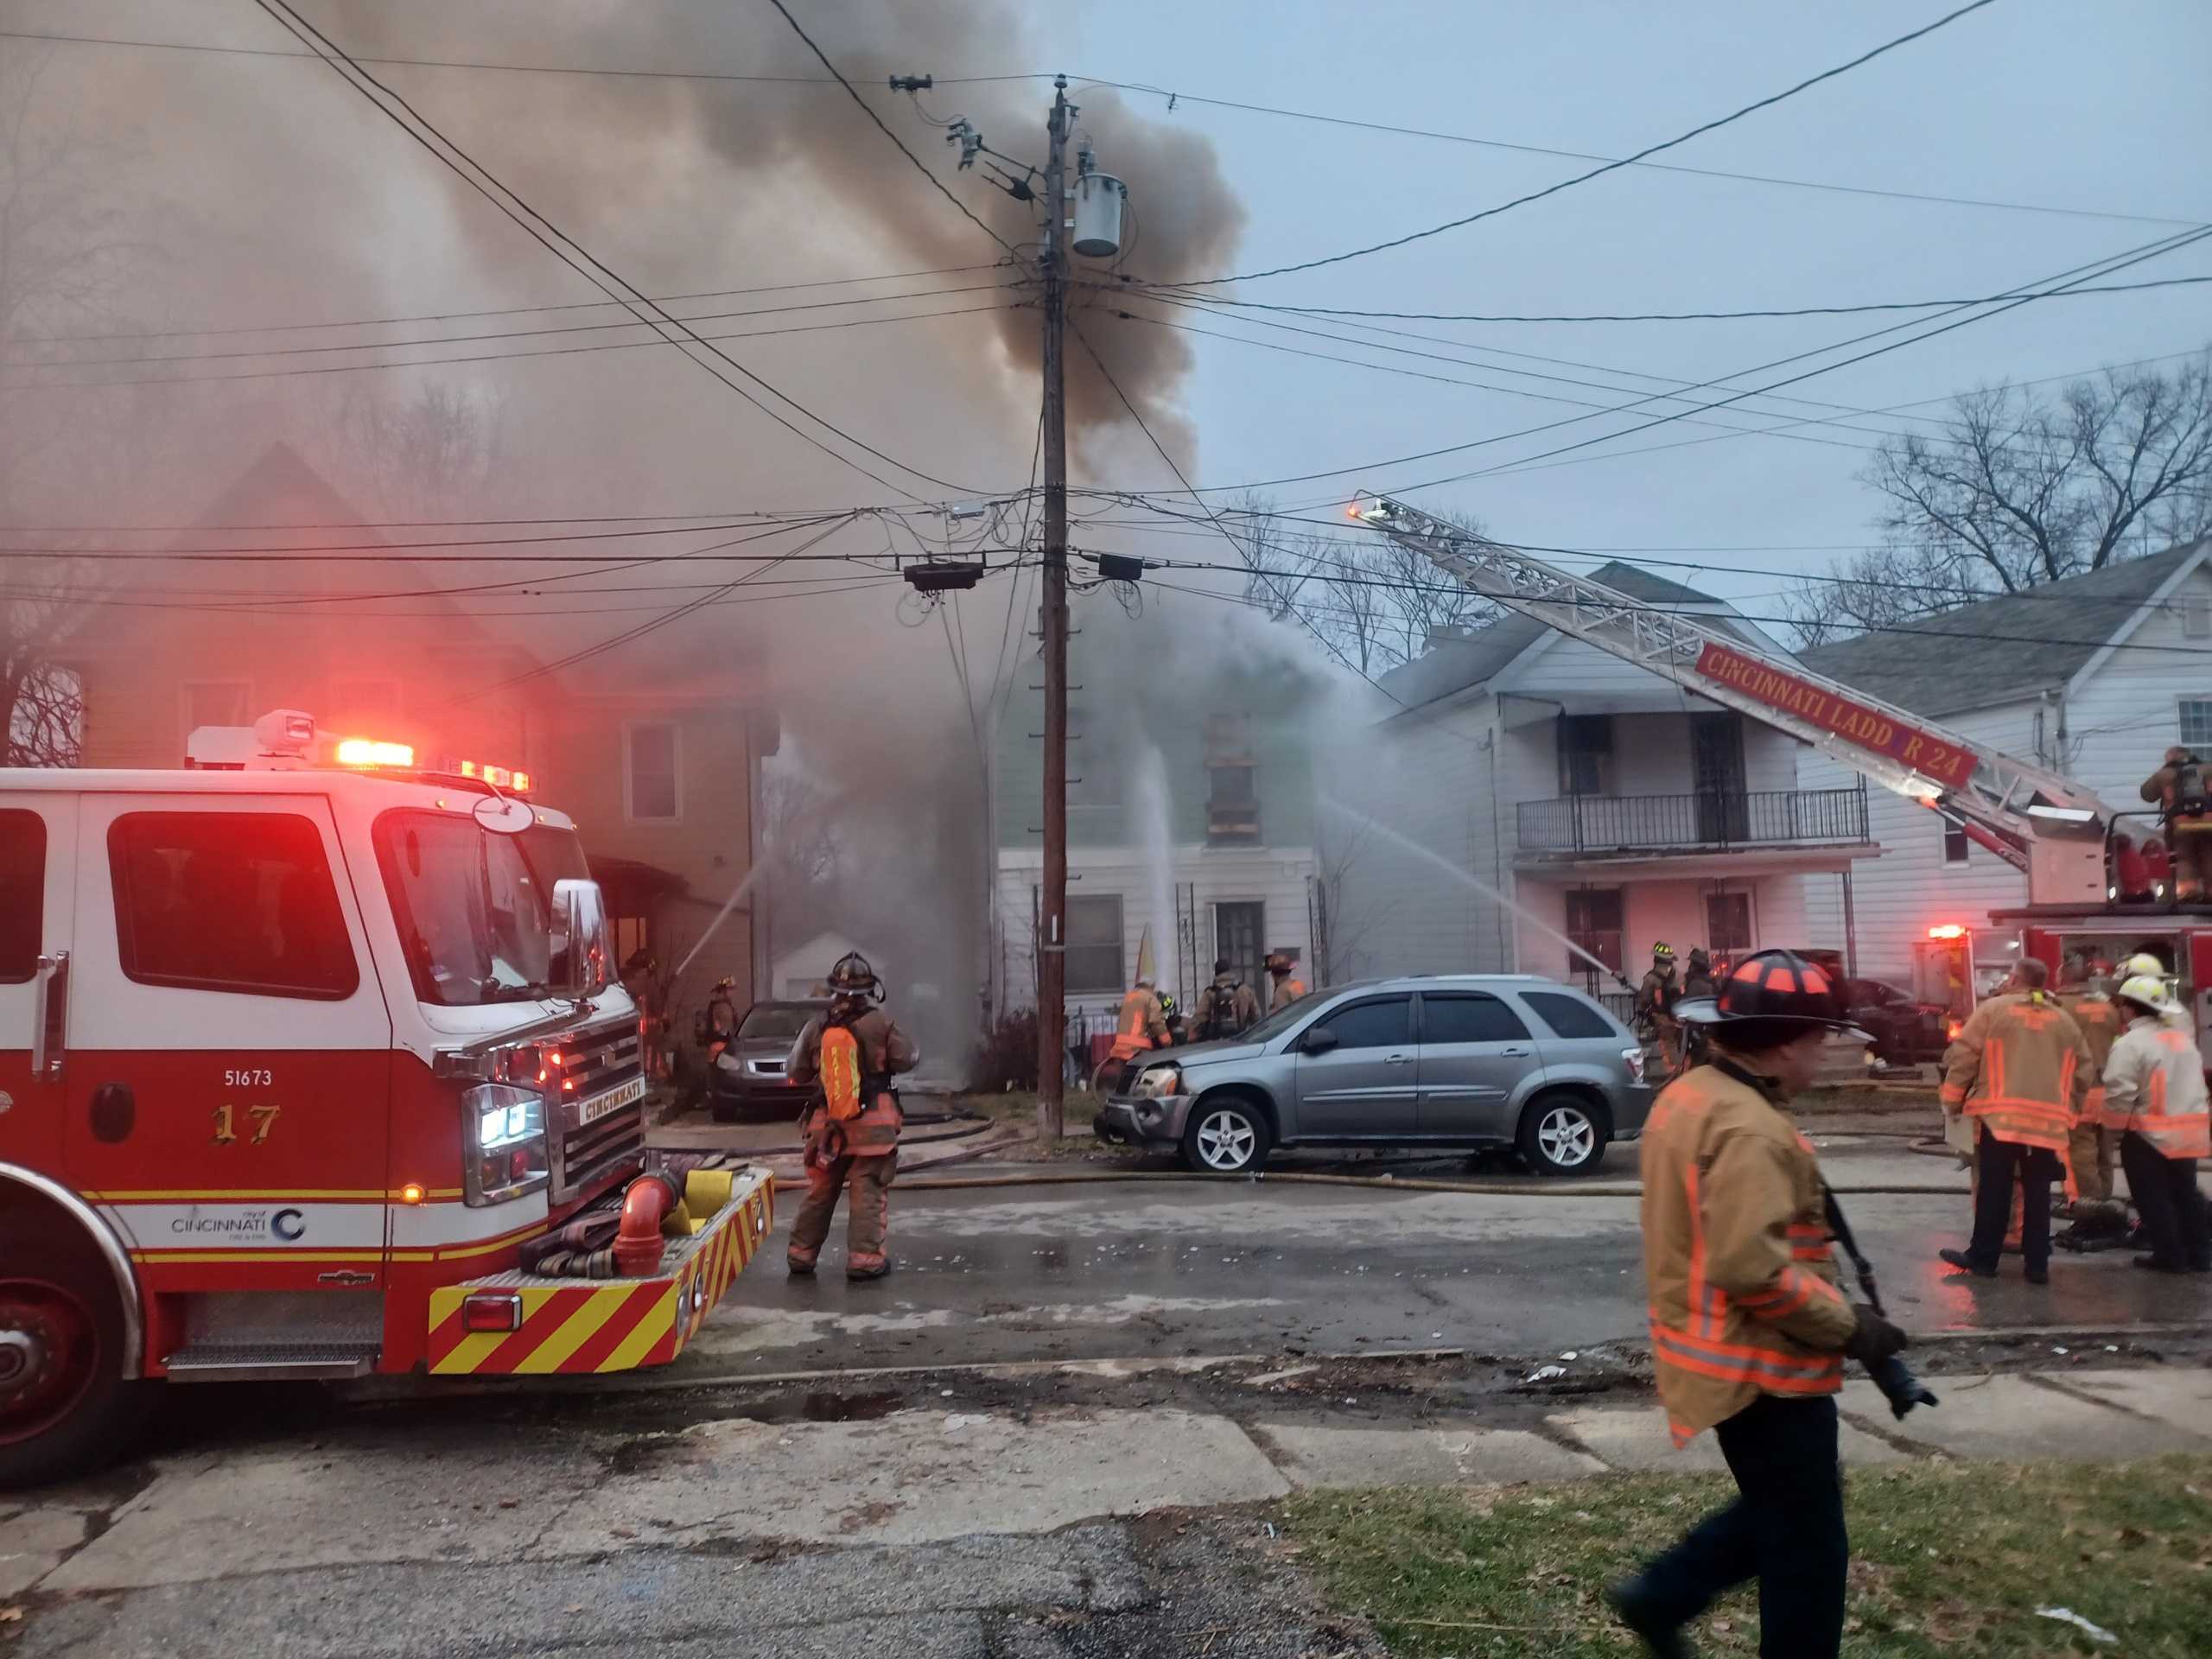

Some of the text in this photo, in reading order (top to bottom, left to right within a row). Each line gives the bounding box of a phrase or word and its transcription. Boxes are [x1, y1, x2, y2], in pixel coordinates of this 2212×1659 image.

[1707, 652, 1827, 718] CINCINNATI
[1926, 747, 1961, 776] 24
[225, 1070, 271, 1086] 51673
[586, 1081, 641, 1121] CINCINNATI
[211, 1104, 281, 1145] 17
[172, 1218, 266, 1233] CINCINNATI
